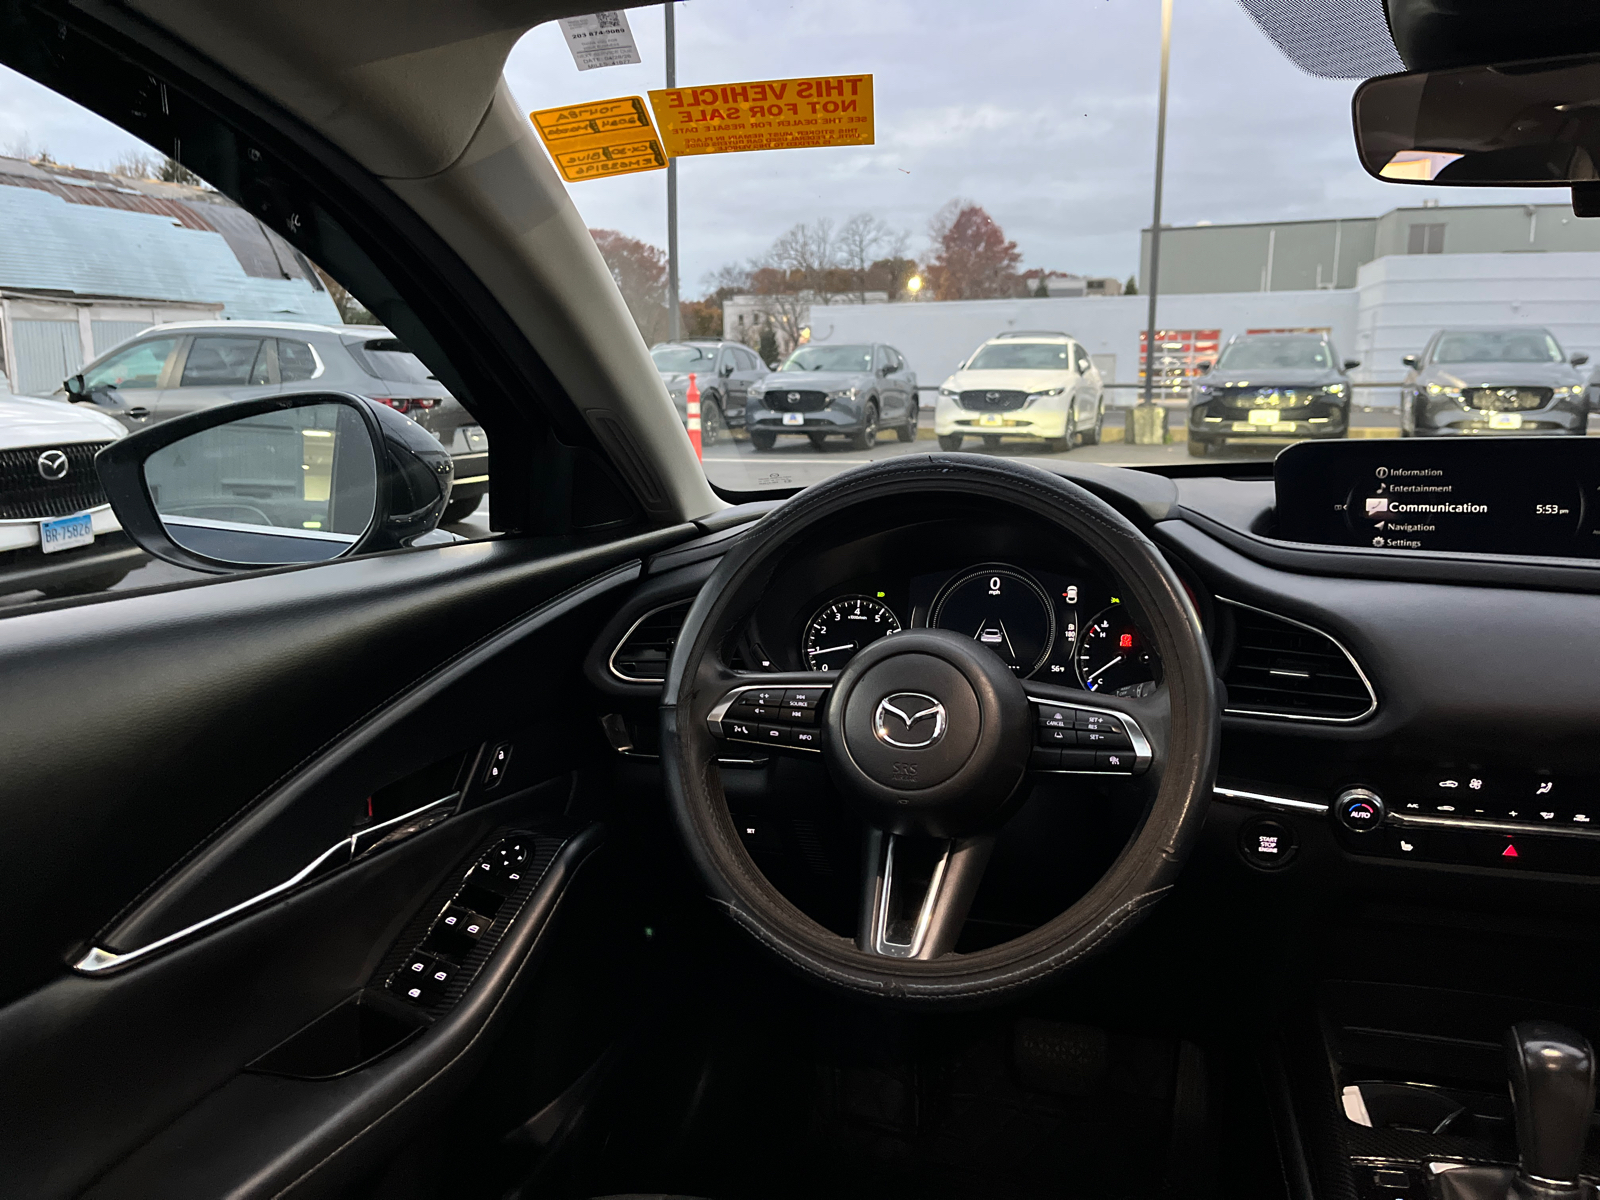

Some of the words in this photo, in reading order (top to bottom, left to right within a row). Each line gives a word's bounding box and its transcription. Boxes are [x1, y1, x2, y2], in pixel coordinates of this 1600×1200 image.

[1390, 468, 1443, 476] Information
[1390, 484, 1452, 492] Entertainment
[1389, 502, 1488, 513] Communication
[1536, 504, 1558, 514] 5:53
[1387, 523, 1436, 532] Navigation
[1386, 538, 1422, 548] Settings
[990, 576, 1000, 590] 0
[834, 613, 840, 621] 3
[874, 614, 880, 622] 5
[820, 626, 826, 634] 2
[892, 762, 918, 776] SRS
